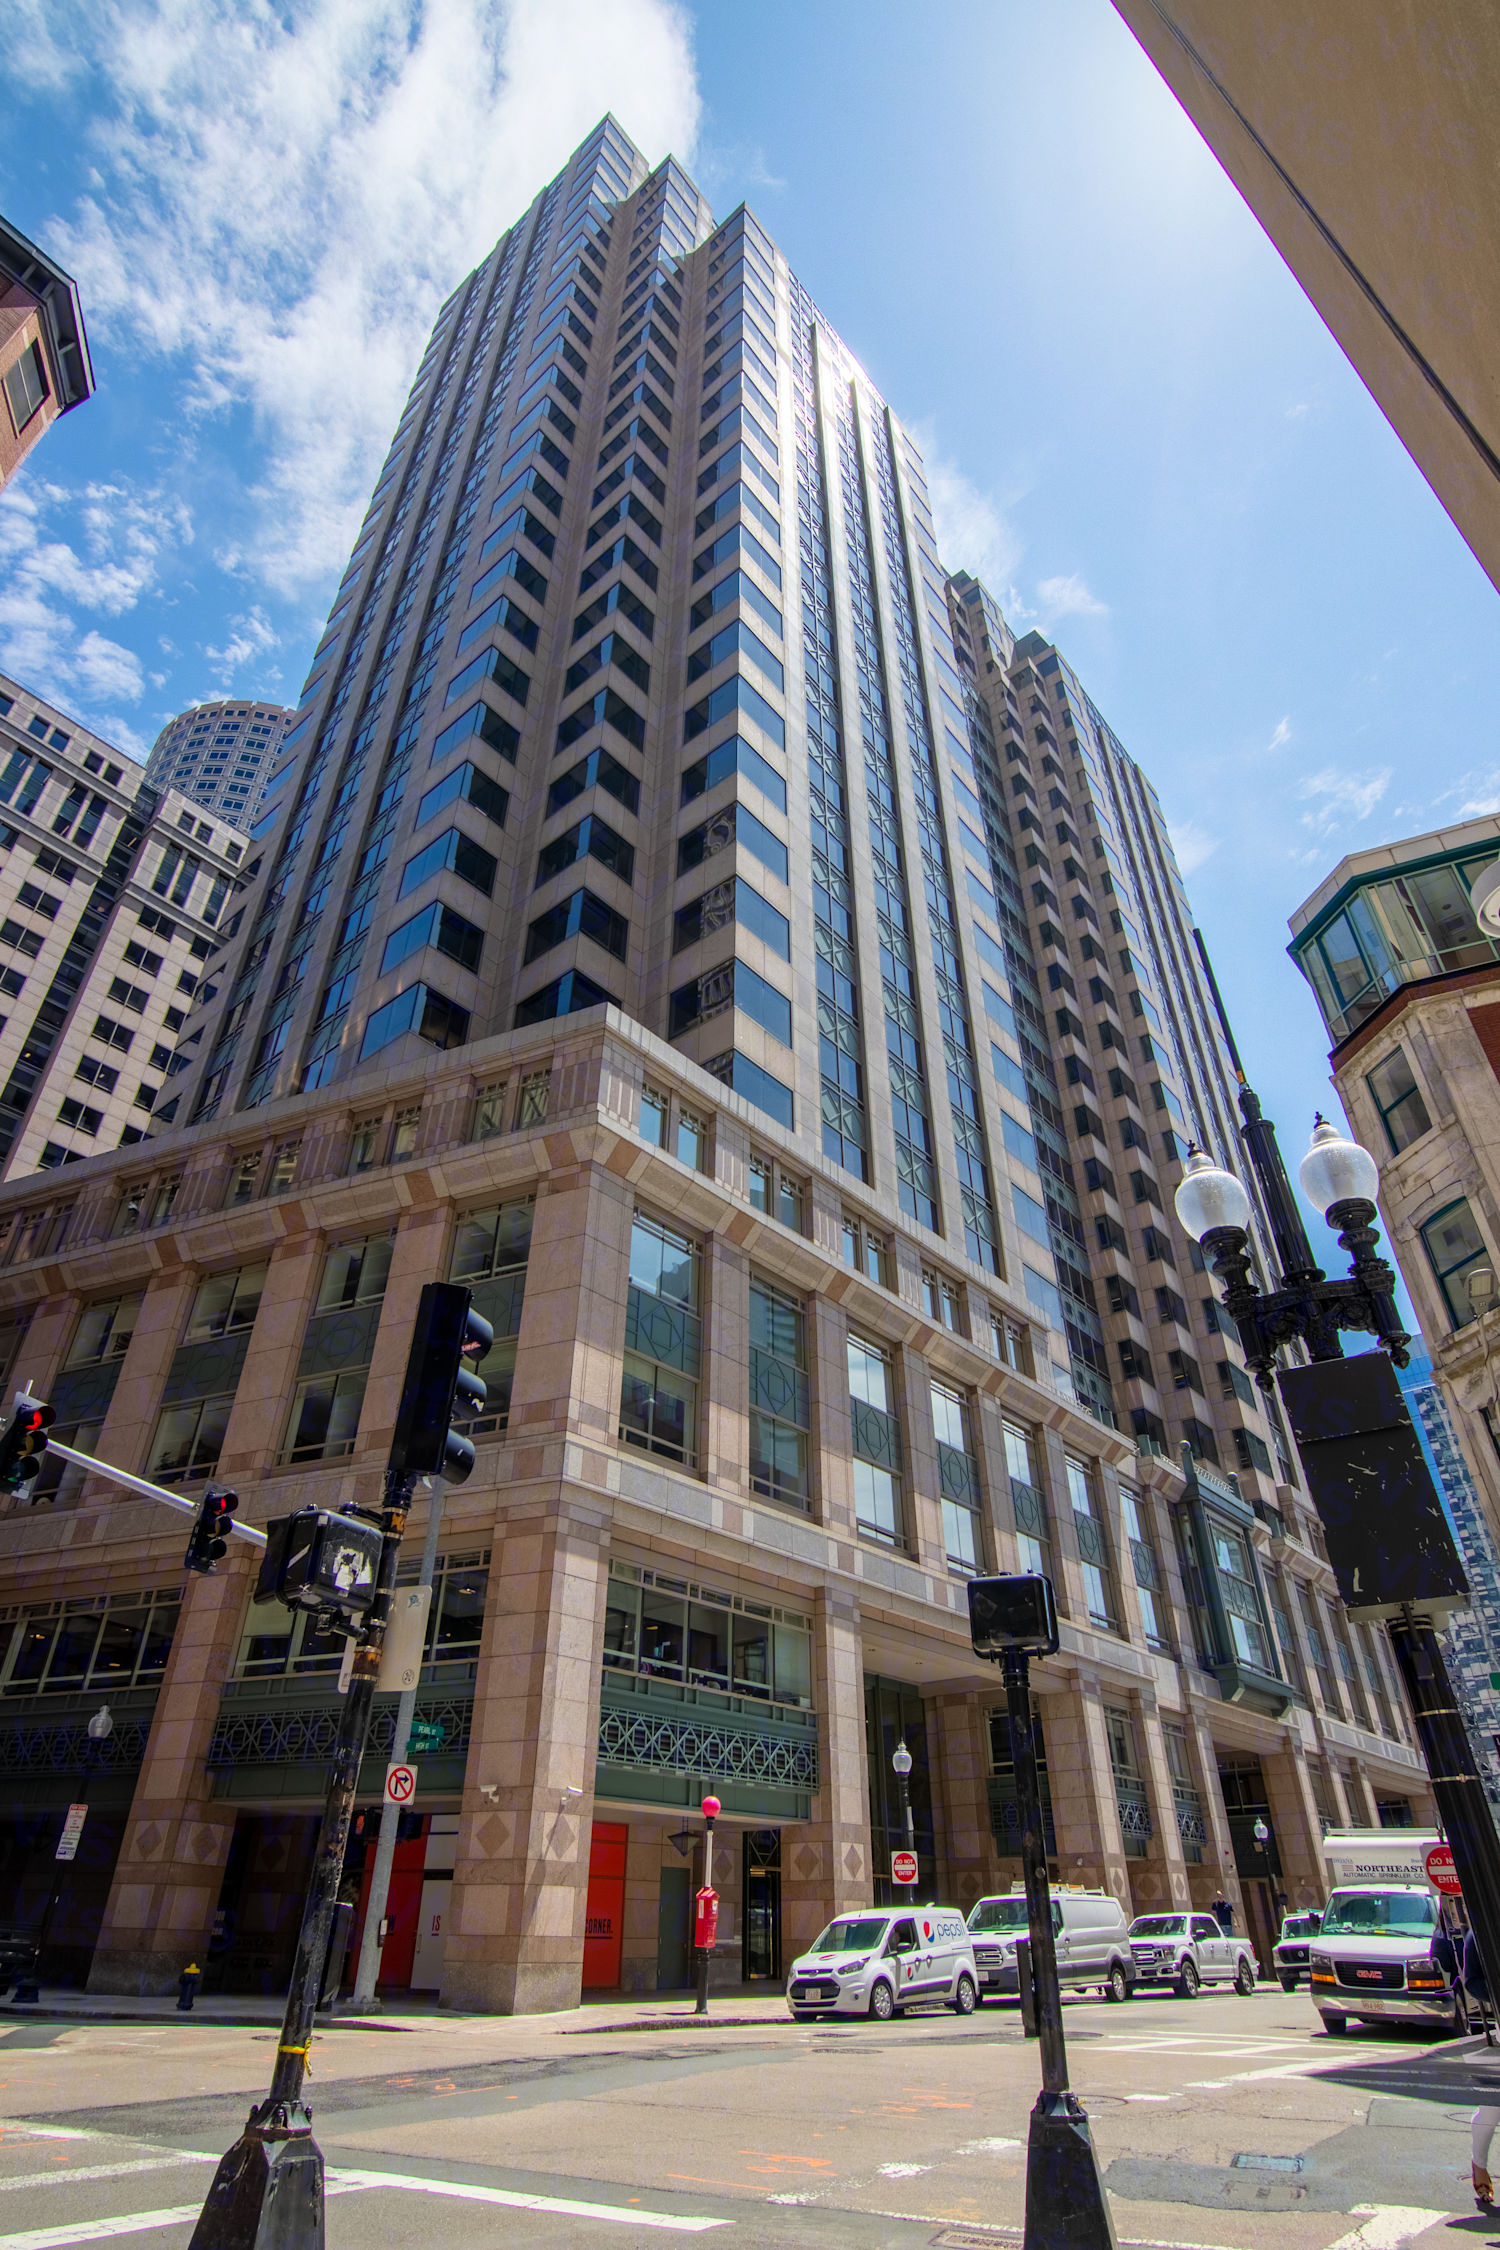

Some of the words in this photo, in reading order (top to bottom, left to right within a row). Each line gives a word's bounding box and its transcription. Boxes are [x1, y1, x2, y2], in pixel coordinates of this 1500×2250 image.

[1430, 1857, 1443, 1865] DO
[1355, 1864, 1425, 1873] NORTHEAST
[1437, 1875, 1459, 1884] ENTE
[1356, 1969, 1383, 1979] GMC
